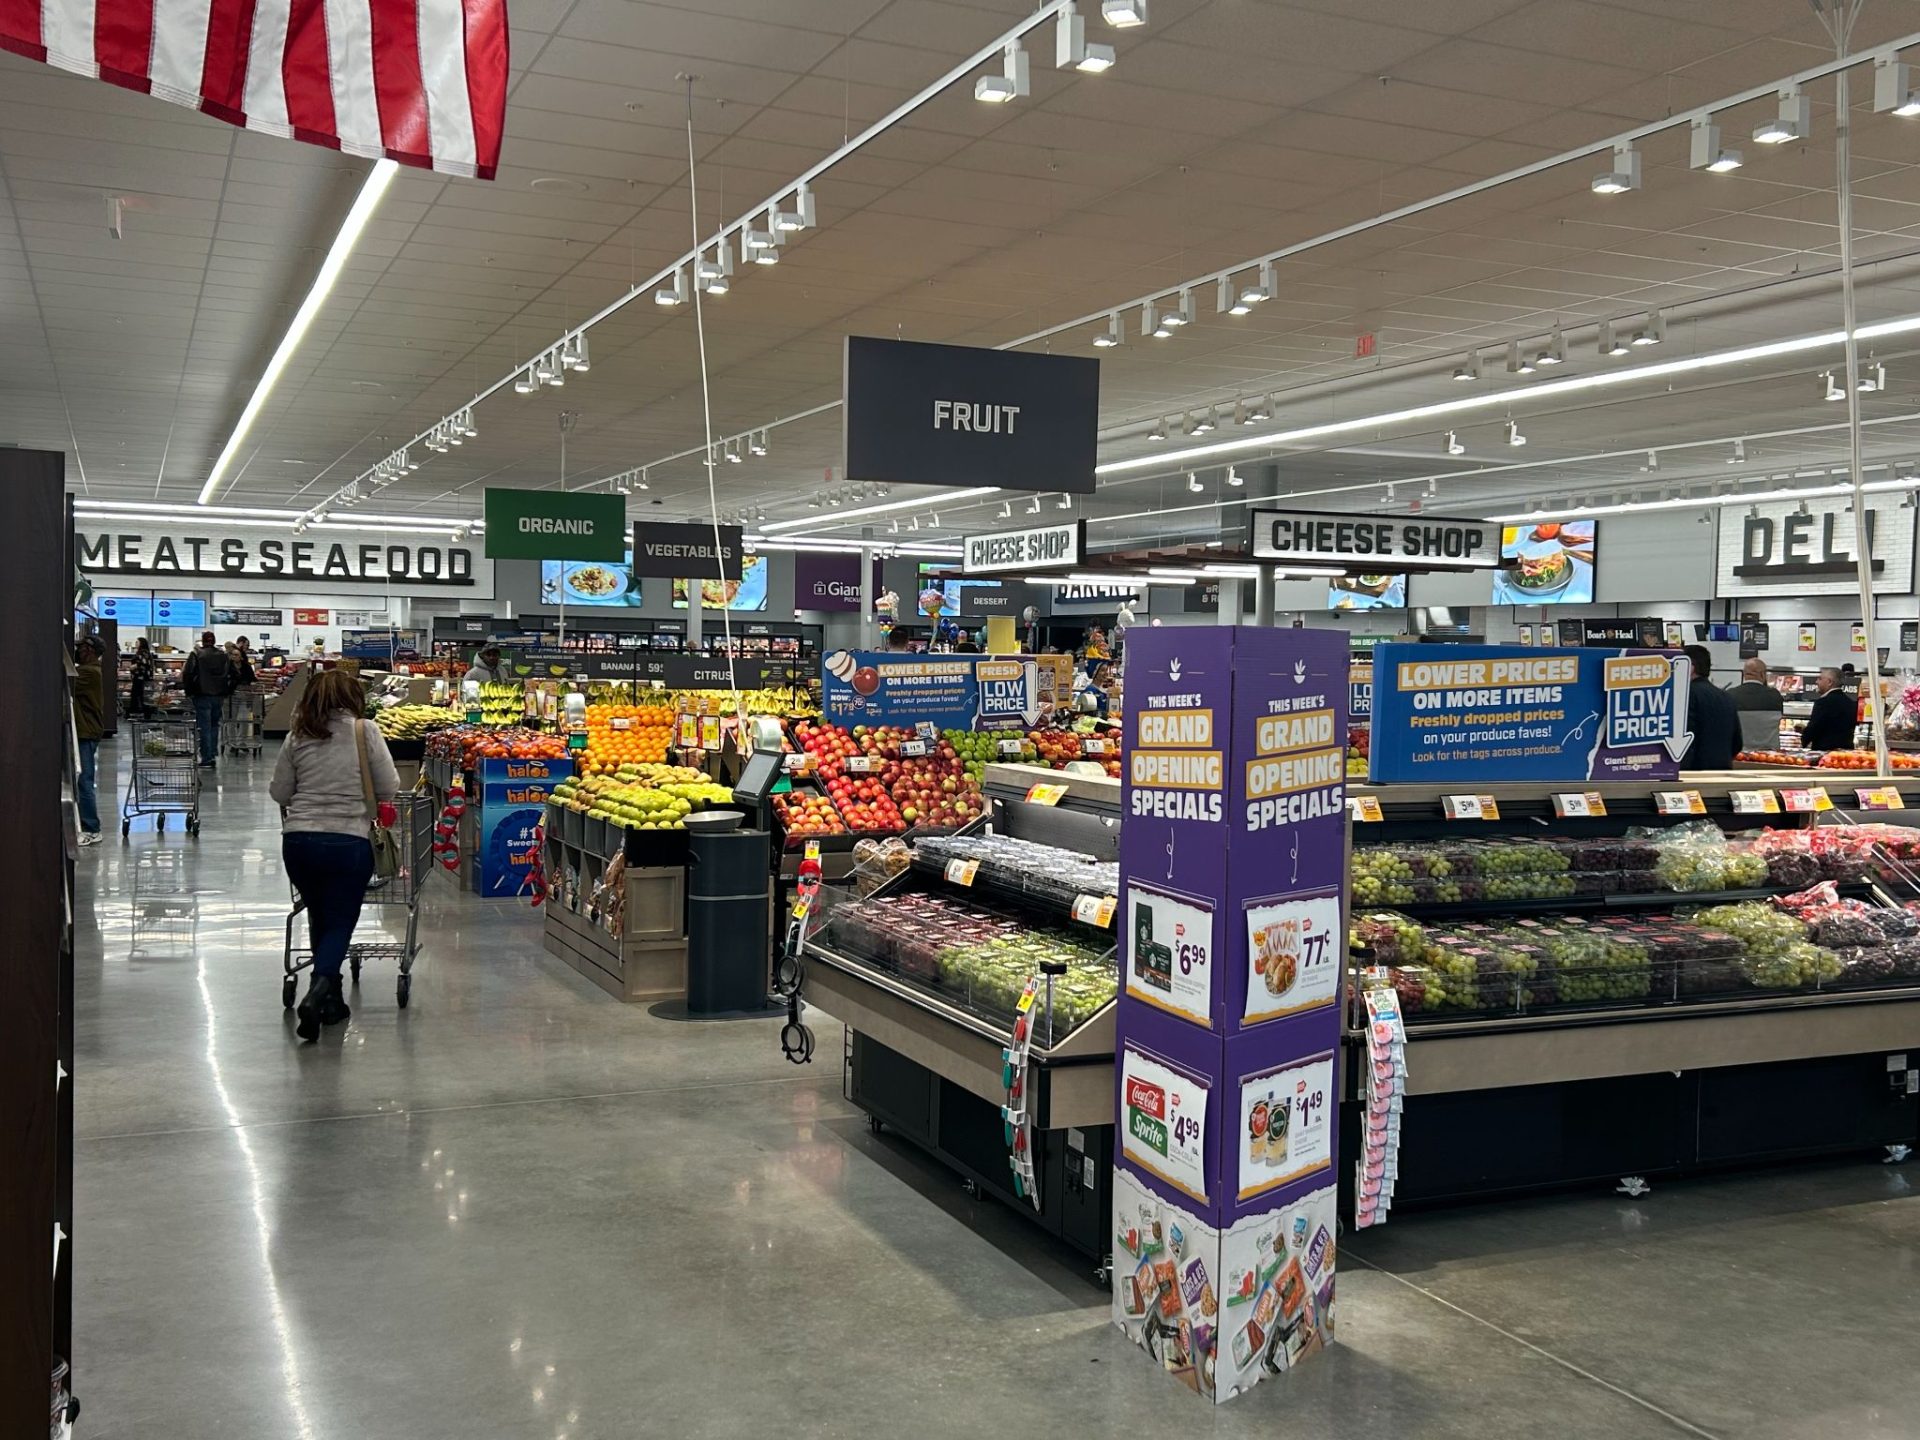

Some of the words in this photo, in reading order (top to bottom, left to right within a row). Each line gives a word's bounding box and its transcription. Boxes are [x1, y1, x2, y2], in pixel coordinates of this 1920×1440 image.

[934, 401, 1020, 434] FRUIT
[518, 517, 594, 535] ORGANIC
[1271, 519, 1393, 555] CHEESE
[1403, 526, 1483, 559] SHOP
[1743, 509, 1876, 566] DELI
[645, 543, 732, 559] VEGETABLES
[970, 536, 1025, 566] CHEESE
[1028, 530, 1070, 561] SHOP
[828, 581, 863, 596] Gian
[973, 597, 1008, 606] DESSERT
[1587, 630, 1606, 639] Boar's
[1615, 630, 1634, 638] Head
[600, 662, 641, 671] BANANAS
[694, 670, 732, 681] CITRUS
[880, 664, 923, 676] LOWER
[926, 662, 970, 674] PRICES
[980, 666, 1018, 676] FRESH
[1350, 670, 1372, 678] FRE
[1401, 663, 1486, 687] LOWER
[1491, 659, 1575, 683] PRICES
[1610, 664, 1664, 682] FRESH
[886, 678, 901, 686] ON
[903, 676, 932, 685] MORE
[933, 675, 964, 684] ITEMS
[984, 681, 1024, 697] LOW
[1354, 684, 1372, 698] LO
[1413, 692, 1441, 710] ON
[1446, 689, 1501, 708] MORE
[1506, 686, 1562, 705] ITEMS
[985, 697, 1025, 711] PRICE
[1148, 696, 1166, 708] THIS
[1168, 693, 1201, 707] WEEK'S
[1268, 699, 1290, 713] THIS
[1292, 694, 1325, 711] WEEK'S
[1614, 688, 1670, 717] LOW
[1410, 713, 1460, 728] Freshly
[1464, 710, 1521, 727] dropped
[1524, 709, 1565, 722] prices
[1614, 716, 1670, 739] PRICE
[1141, 715, 1210, 743] GRAND
[1260, 714, 1331, 751] GRAND
[1423, 733, 1438, 745] on
[1441, 732, 1466, 745] your
[1469, 728, 1516, 743] produce
[1518, 725, 1552, 738] faves!
[1412, 751, 1435, 763] Look
[1437, 750, 1450, 761] for
[1452, 749, 1468, 760] the
[1470, 748, 1490, 762] tags
[1491, 747, 1522, 758] across
[1523, 744, 1563, 758] produce.
[507, 763, 550, 778] halos
[1133, 756, 1219, 785] OPENING
[1249, 752, 1340, 794] OPENING
[507, 788, 549, 803] halos
[1131, 789, 1222, 822] SPECIALS
[1247, 786, 1342, 831] SPECIALS
[519, 827, 536, 839] #1
[510, 853, 533, 865] hal
[1134, 1114, 1163, 1148] Sprite
